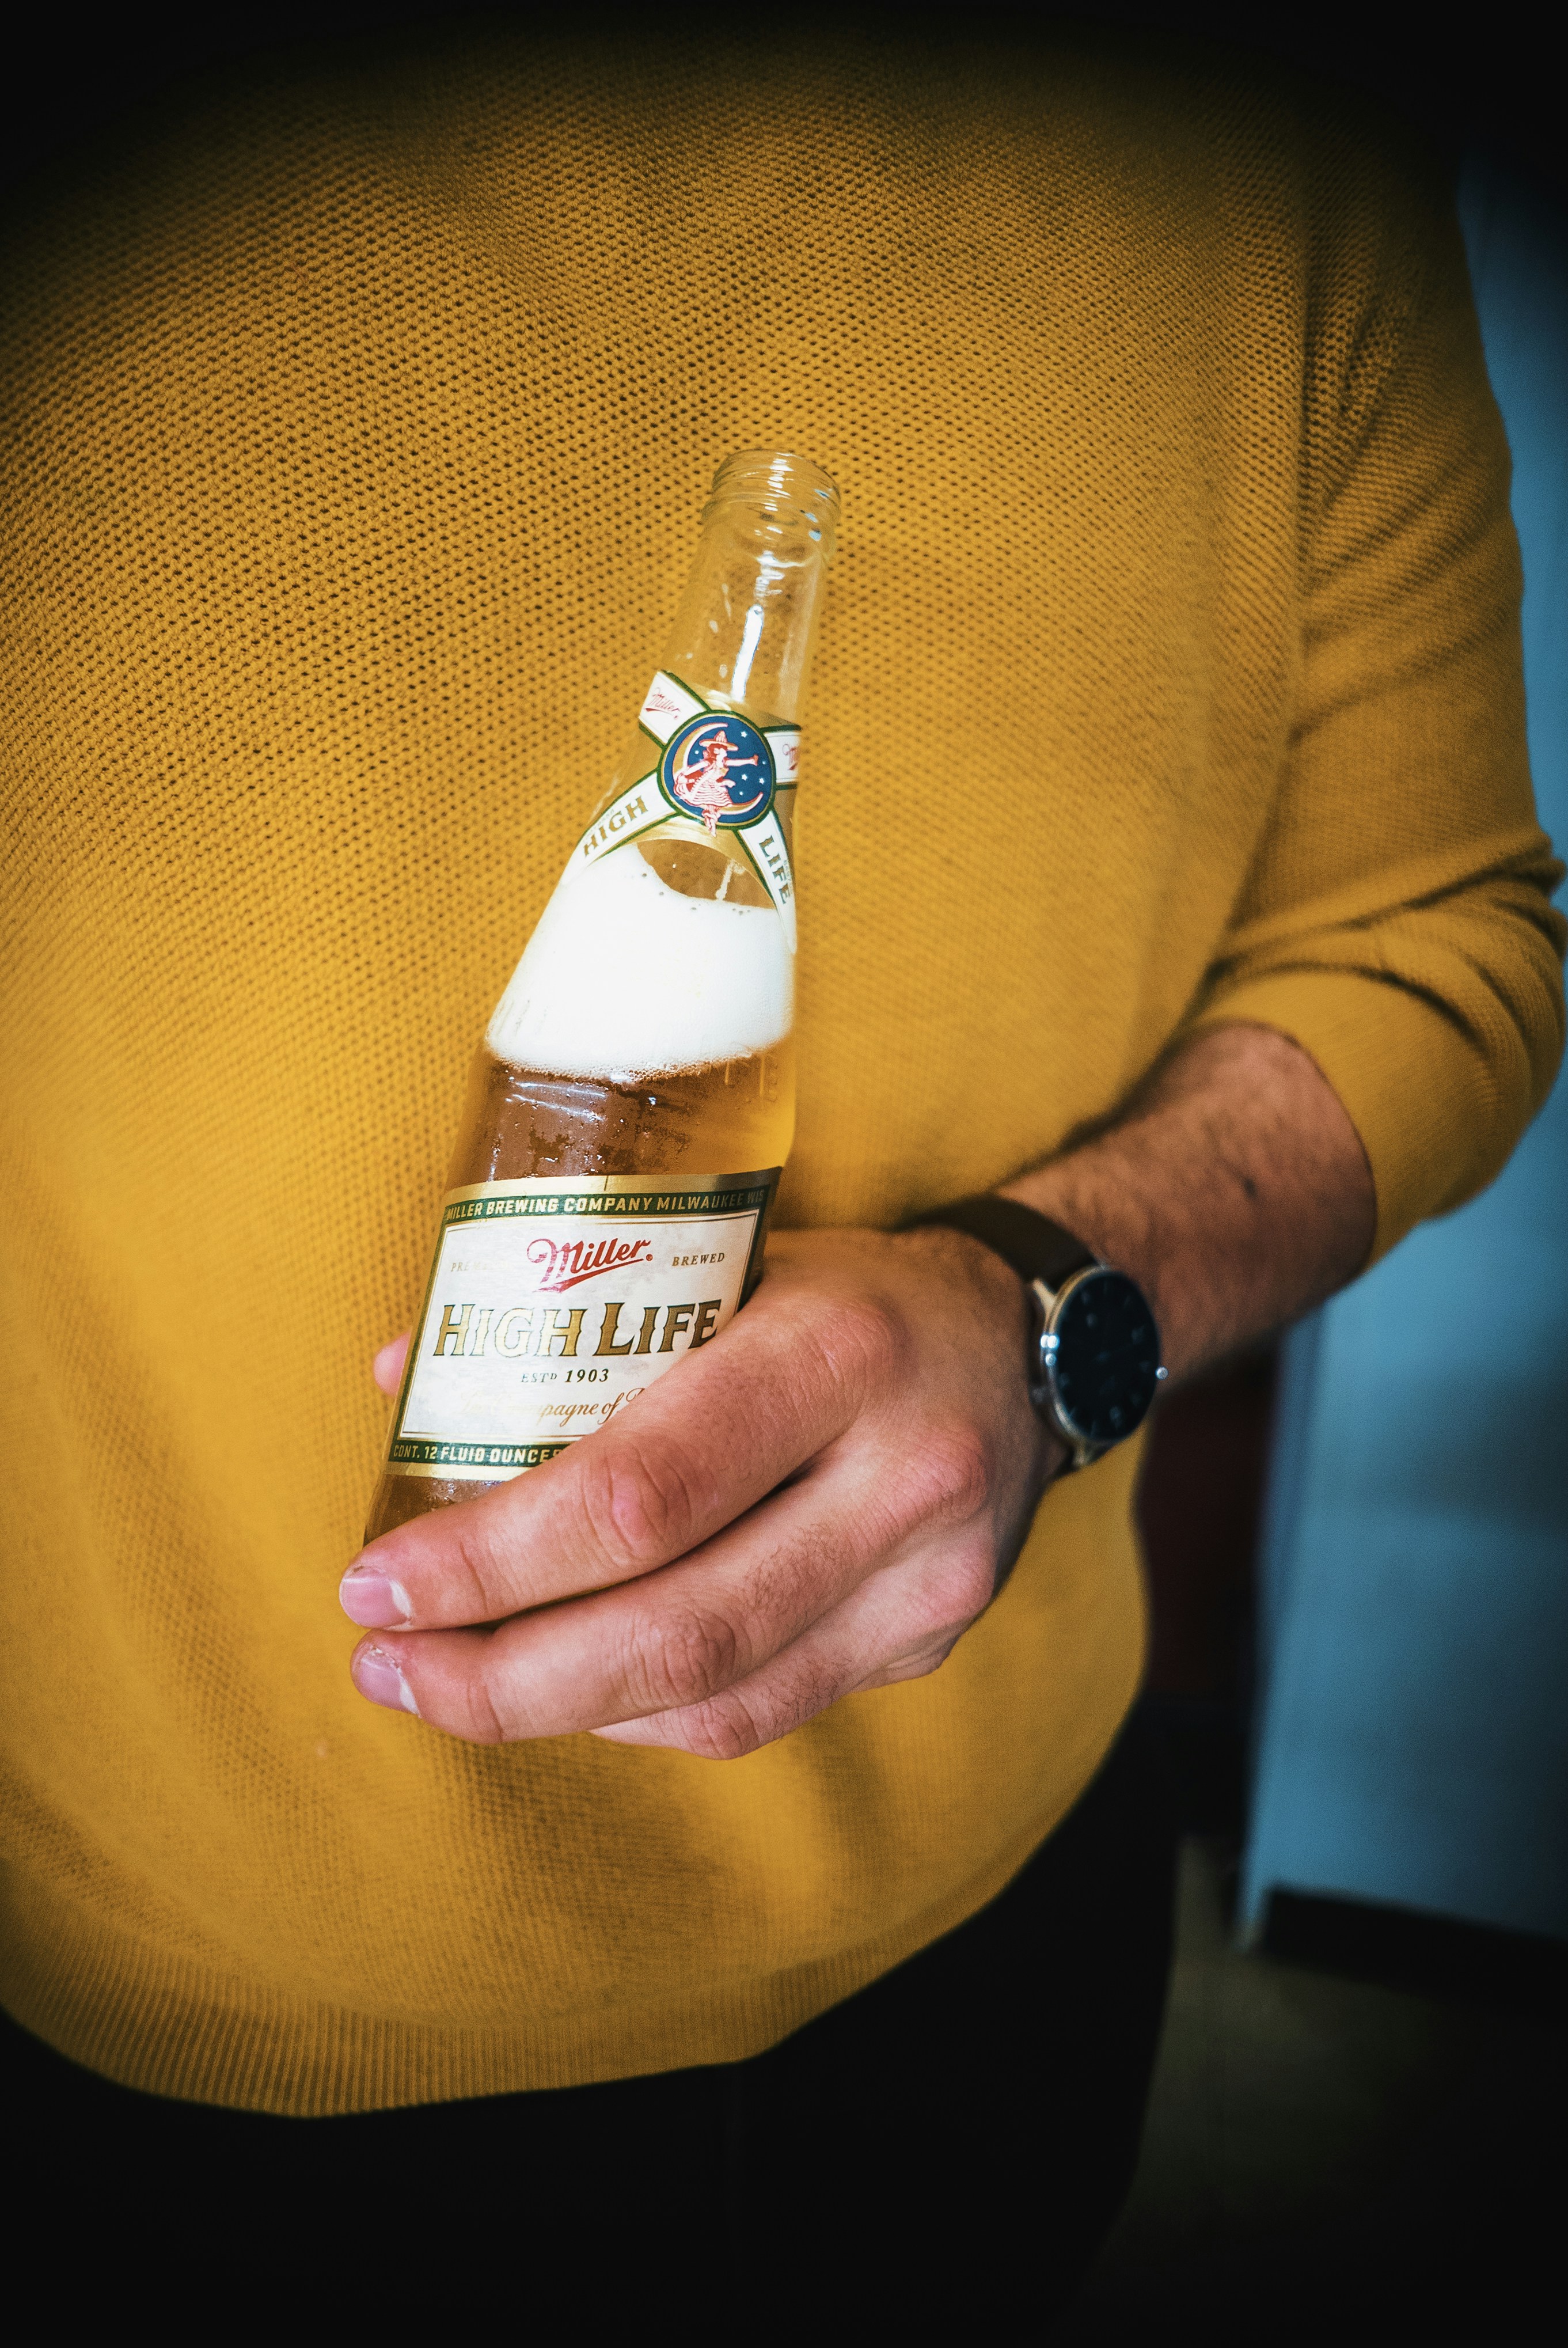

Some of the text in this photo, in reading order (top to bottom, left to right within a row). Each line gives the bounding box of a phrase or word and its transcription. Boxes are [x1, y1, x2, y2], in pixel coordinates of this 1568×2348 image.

[583, 795, 648, 856] HIGH
[759, 834, 790, 904] LIFE
[447, 1202, 483, 1220] MILLER
[485, 1197, 559, 1216] BREWING
[563, 1197, 653, 1212] COMPANY
[656, 1193, 745, 1211] MILWAUKEE
[526, 1238, 652, 1288] Miller
[672, 1252, 725, 1267] BREWED
[432, 1299, 722, 1357] HIGH LIFE
[564, 1368, 609, 1383] 1903
[597, 1392, 625, 1425] of
[393, 1444, 420, 1459] CONT.
[424, 1446, 438, 1460] 12
[441, 1446, 485, 1463] FLUID
